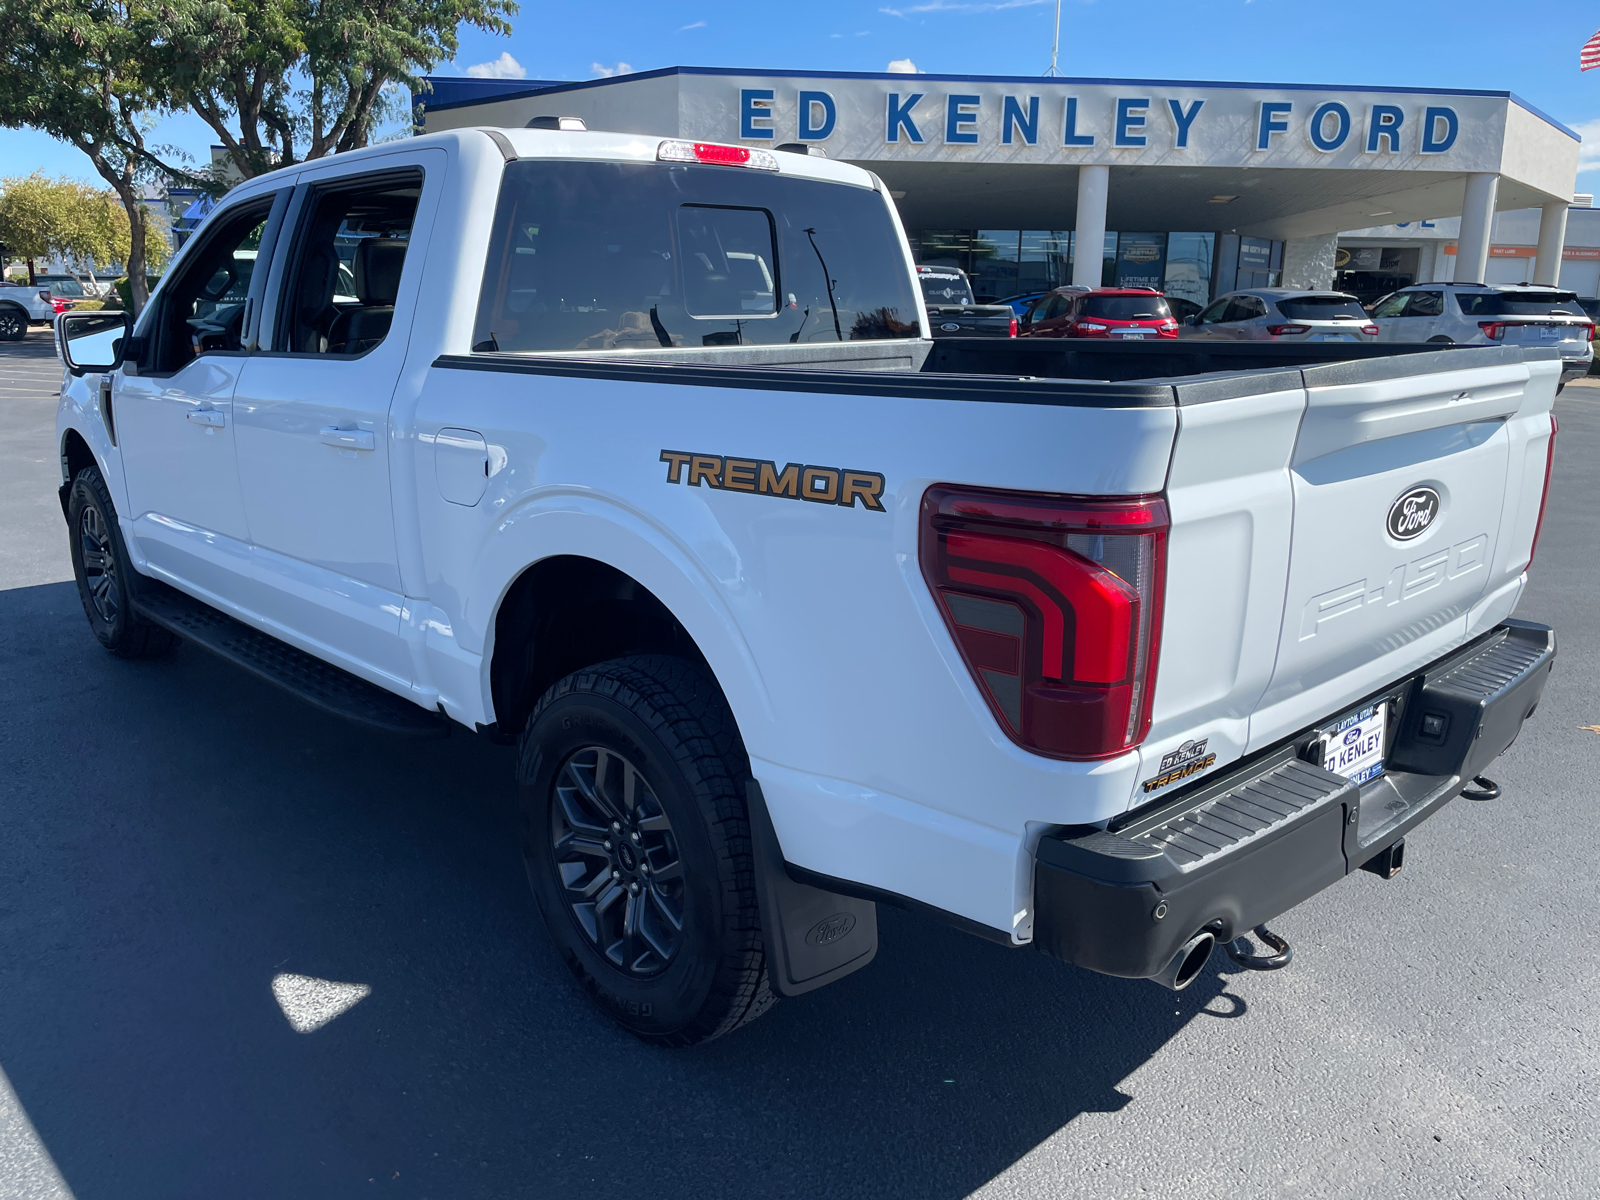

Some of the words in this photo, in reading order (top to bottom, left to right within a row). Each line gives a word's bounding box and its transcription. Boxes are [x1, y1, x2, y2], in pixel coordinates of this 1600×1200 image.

[739, 88, 837, 142] ED
[885, 91, 1208, 150] KENLEY
[1256, 99, 1460, 156] FORD
[659, 449, 887, 513] TREMOR
[1397, 495, 1433, 533] Ford
[1298, 532, 1489, 642] F-150
[1359, 706, 1374, 720] UTAH
[1161, 757, 1173, 770] ED
[1173, 743, 1207, 765] KENLEY
[1339, 731, 1381, 768] KENLEY
[1144, 754, 1217, 793] TREMOR
[1350, 767, 1371, 785] NLEY
[815, 917, 848, 944] Ford
